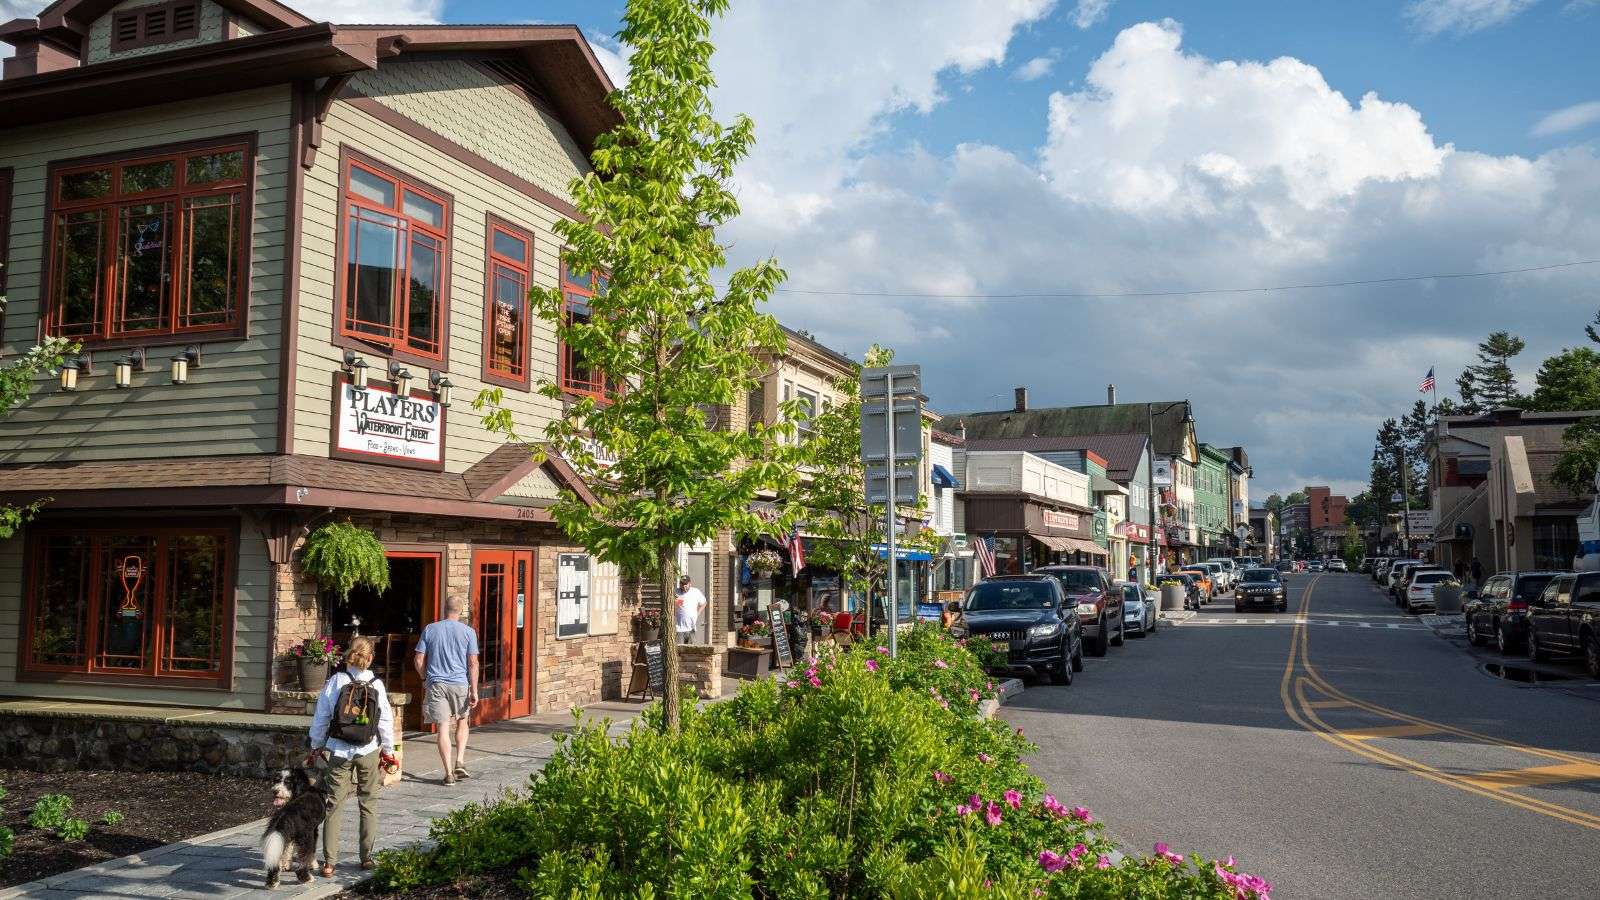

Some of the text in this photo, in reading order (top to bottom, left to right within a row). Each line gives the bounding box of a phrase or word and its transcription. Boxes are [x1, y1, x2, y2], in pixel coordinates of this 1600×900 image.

[350, 389, 435, 424] PLAYERS
[355, 409, 429, 442] WATERFRONT EATERY
[517, 508, 535, 520] 2405
